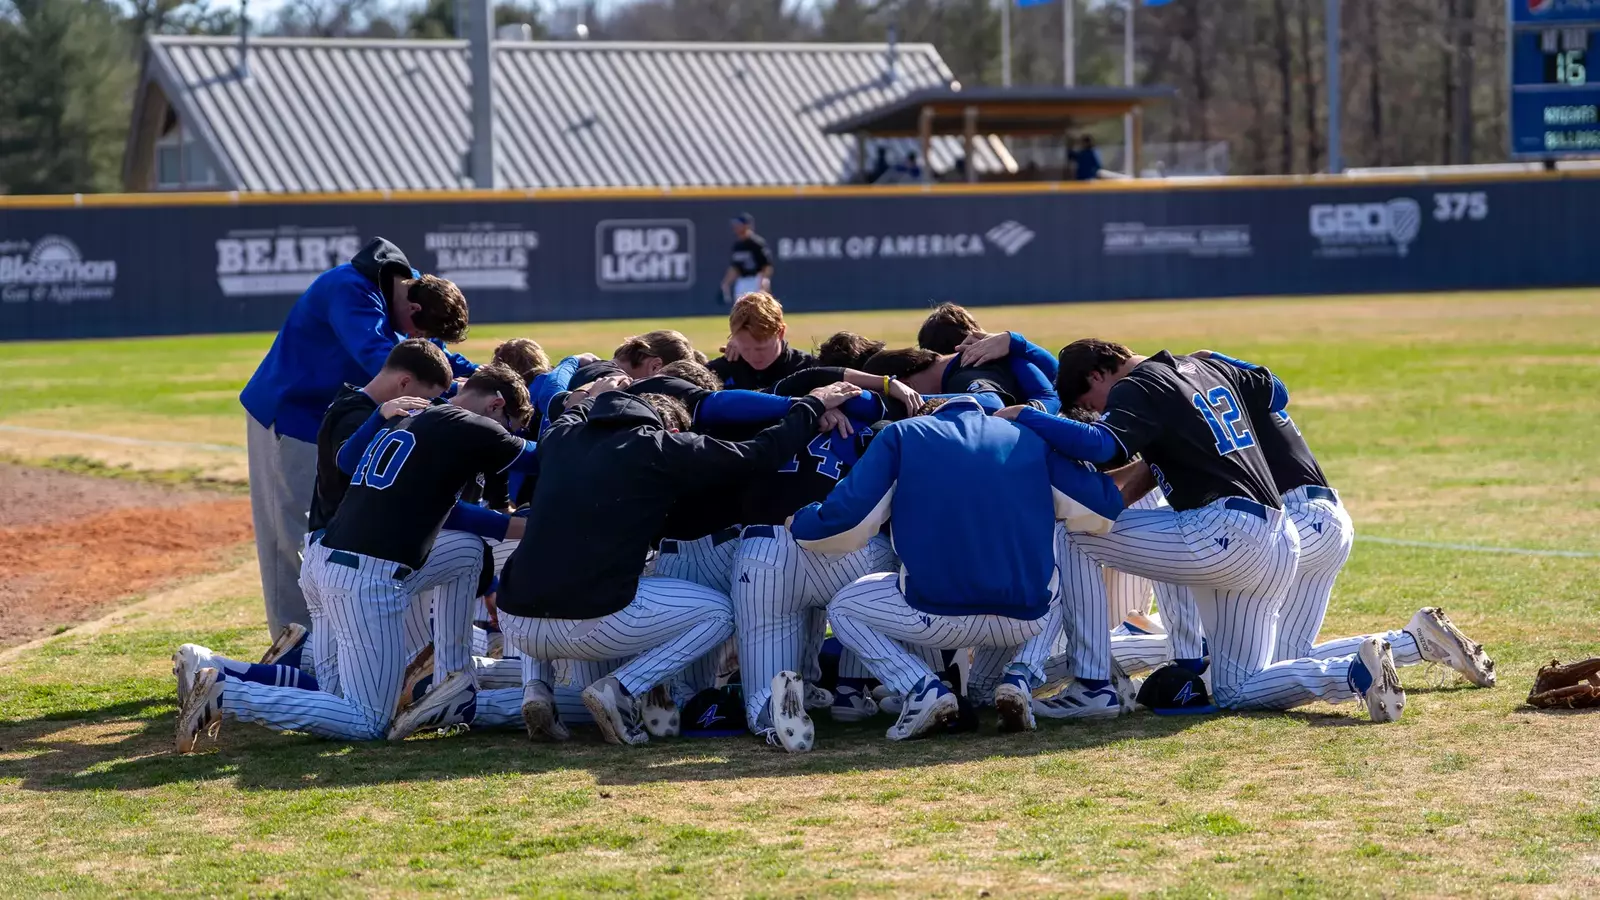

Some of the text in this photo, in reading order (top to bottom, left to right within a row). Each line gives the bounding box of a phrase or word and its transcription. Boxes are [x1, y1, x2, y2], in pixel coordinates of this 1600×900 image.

[1556, 50, 1586, 86] 16
[1433, 191, 1488, 221] 375
[215, 236, 361, 274] BEAR'S
[613, 228, 678, 253] BUD
[778, 237, 842, 260] BANK
[845, 236, 877, 259] OF
[879, 233, 985, 257] AMERICA
[0, 255, 117, 284] Blossman
[436, 248, 529, 270] BAGELS
[602, 253, 690, 281] LIGHT
[1192, 385, 1255, 457] 12
[350, 427, 416, 490] 40
